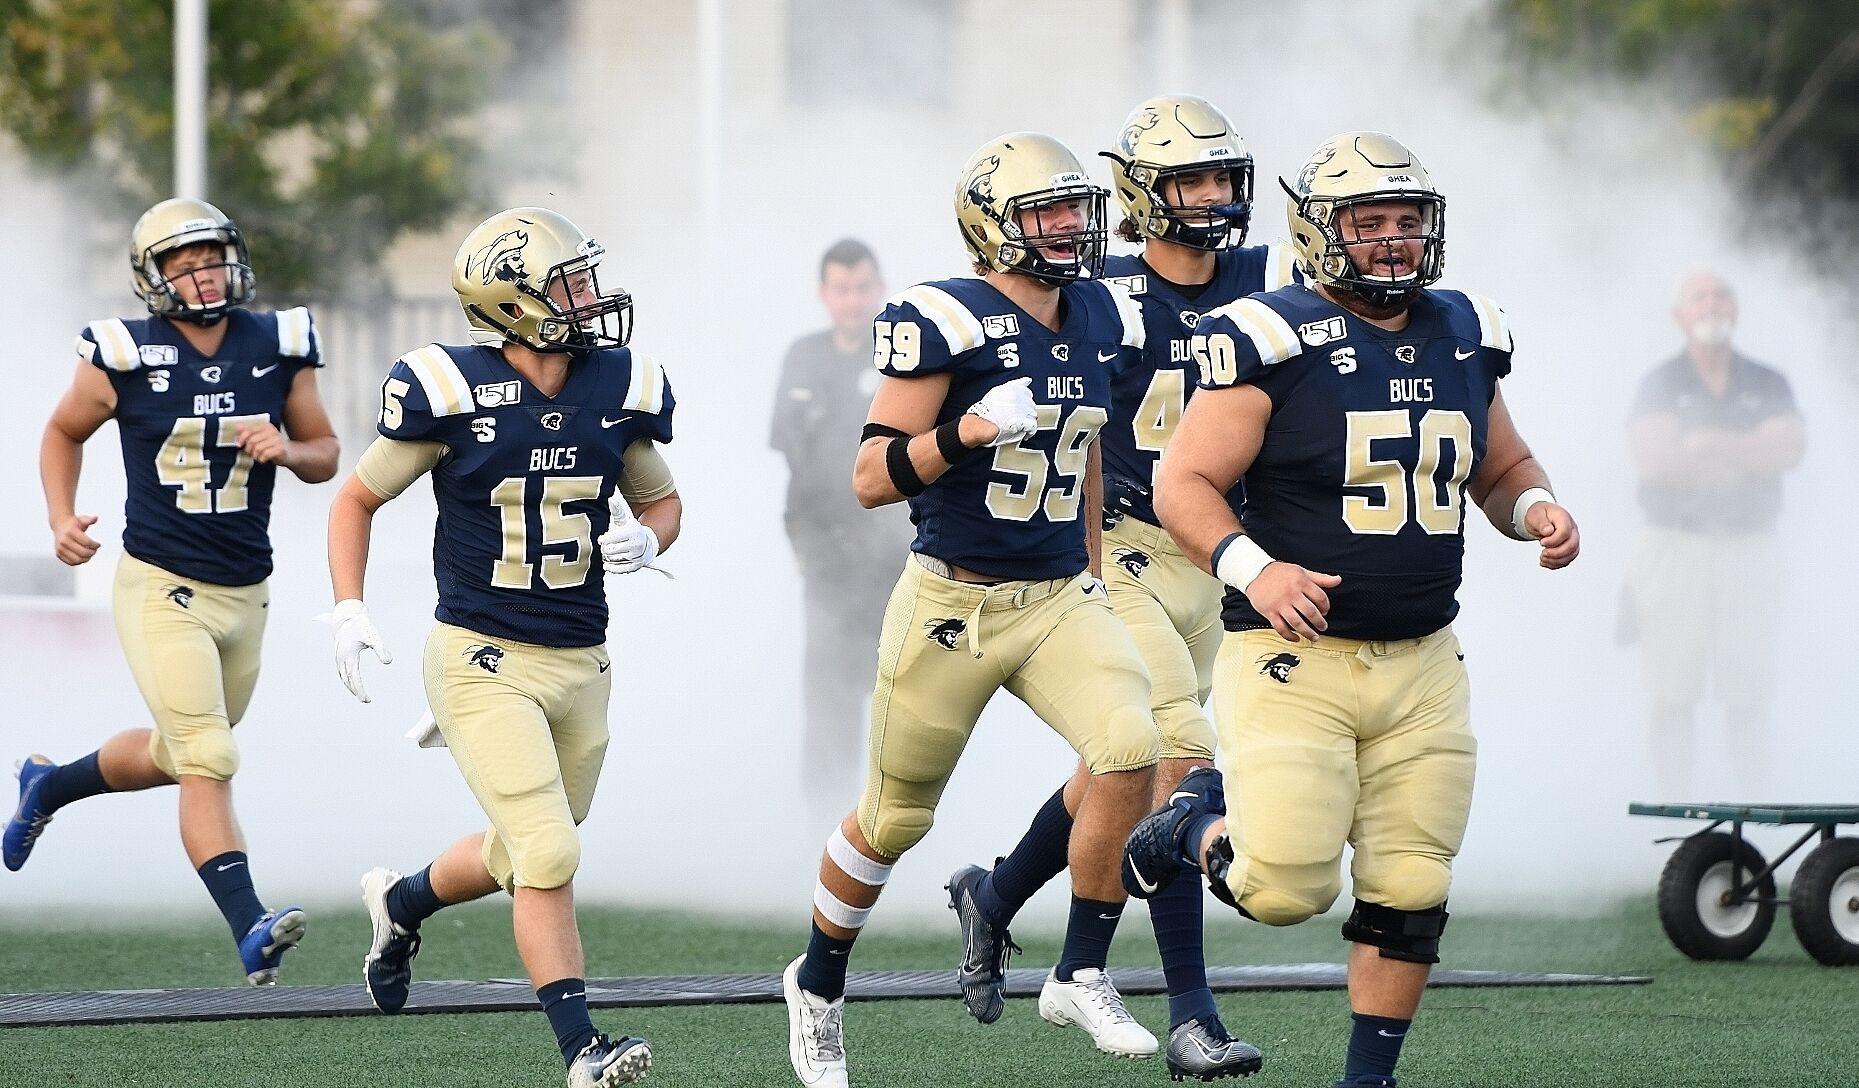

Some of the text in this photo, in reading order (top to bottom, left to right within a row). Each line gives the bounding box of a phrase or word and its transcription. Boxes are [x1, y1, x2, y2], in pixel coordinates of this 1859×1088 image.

[1061, 174, 1081, 183] GHEA
[1388, 175, 1411, 183] GHEA
[982, 313, 1020, 339] 150
[1298, 315, 1347, 347] 150
[873, 320, 921, 372] 59
[1170, 339, 1193, 362] BU
[1191, 333, 1238, 386] 50
[1330, 346, 1357, 374] S
[473, 380, 521, 408] 150
[1047, 376, 1084, 399] BUCS
[1389, 378, 1434, 403] BUCS
[193, 392, 235, 416] BUCS
[471, 417, 496, 442] S
[1132, 368, 1186, 486] 4
[154, 412, 271, 514] 47
[529, 446, 578, 471] BUCS
[985, 405, 1108, 523] 59
[1341, 408, 1473, 537] 50
[490, 475, 604, 591] 15
